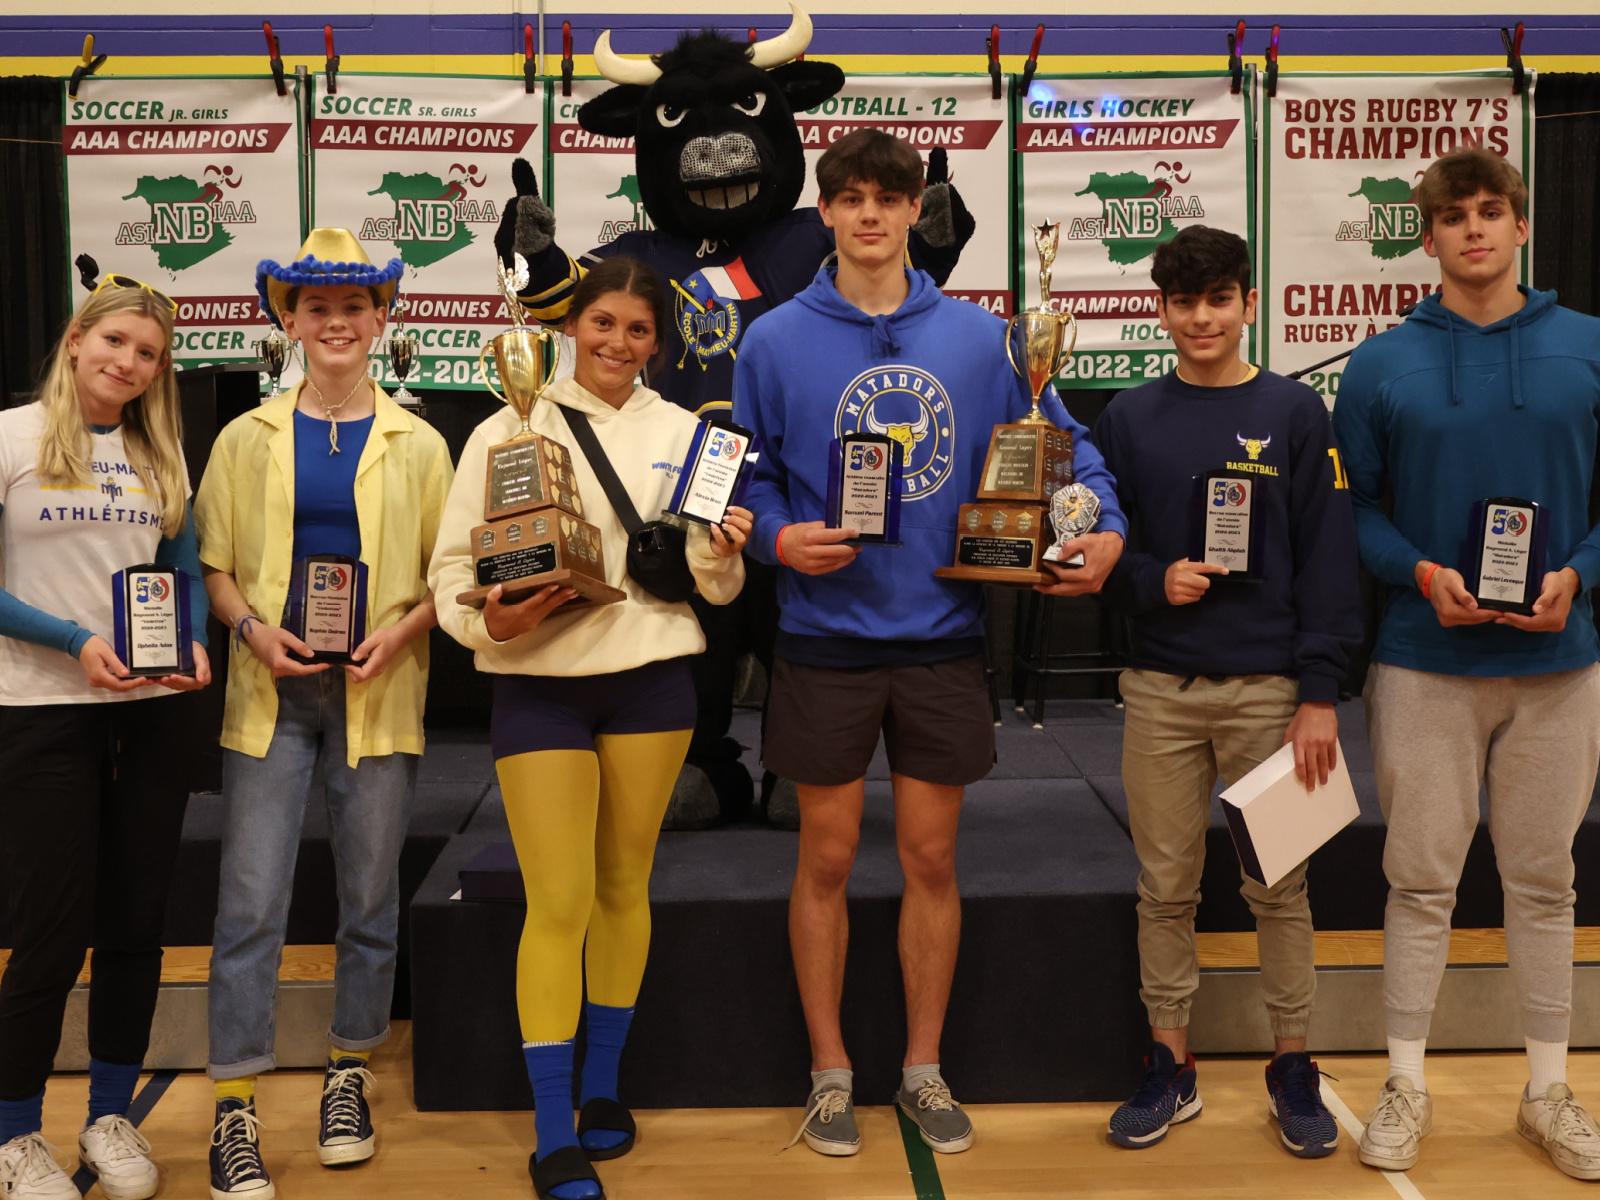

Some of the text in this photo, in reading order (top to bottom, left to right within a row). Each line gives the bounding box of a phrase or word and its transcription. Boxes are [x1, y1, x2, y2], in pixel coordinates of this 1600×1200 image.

[72, 101, 229, 122] SOCCER JR. GIRLS
[320, 95, 477, 118] SOCCER SR. GIRLS
[931, 97, 957, 116] 12
[1028, 98, 1195, 119] GIRLS HOCKEY
[1285, 99, 1356, 123] BOYS
[1367, 98, 1458, 123] RUGBY
[71, 129, 269, 149] AAA CHAMPIONS
[319, 125, 515, 148] AAA CHAMPIONS
[560, 129, 636, 149] CHAM
[1027, 126, 1217, 147] AAA CHAMPIONS
[1285, 126, 1509, 160] CHAMPIONS
[1284, 284, 1443, 317] CHAMP
[1285, 323, 1358, 343] RUGBY
[846, 373, 945, 416] MATADORS
[91, 461, 138, 476] EU-MA
[1226, 461, 1279, 476] BASKETBALL
